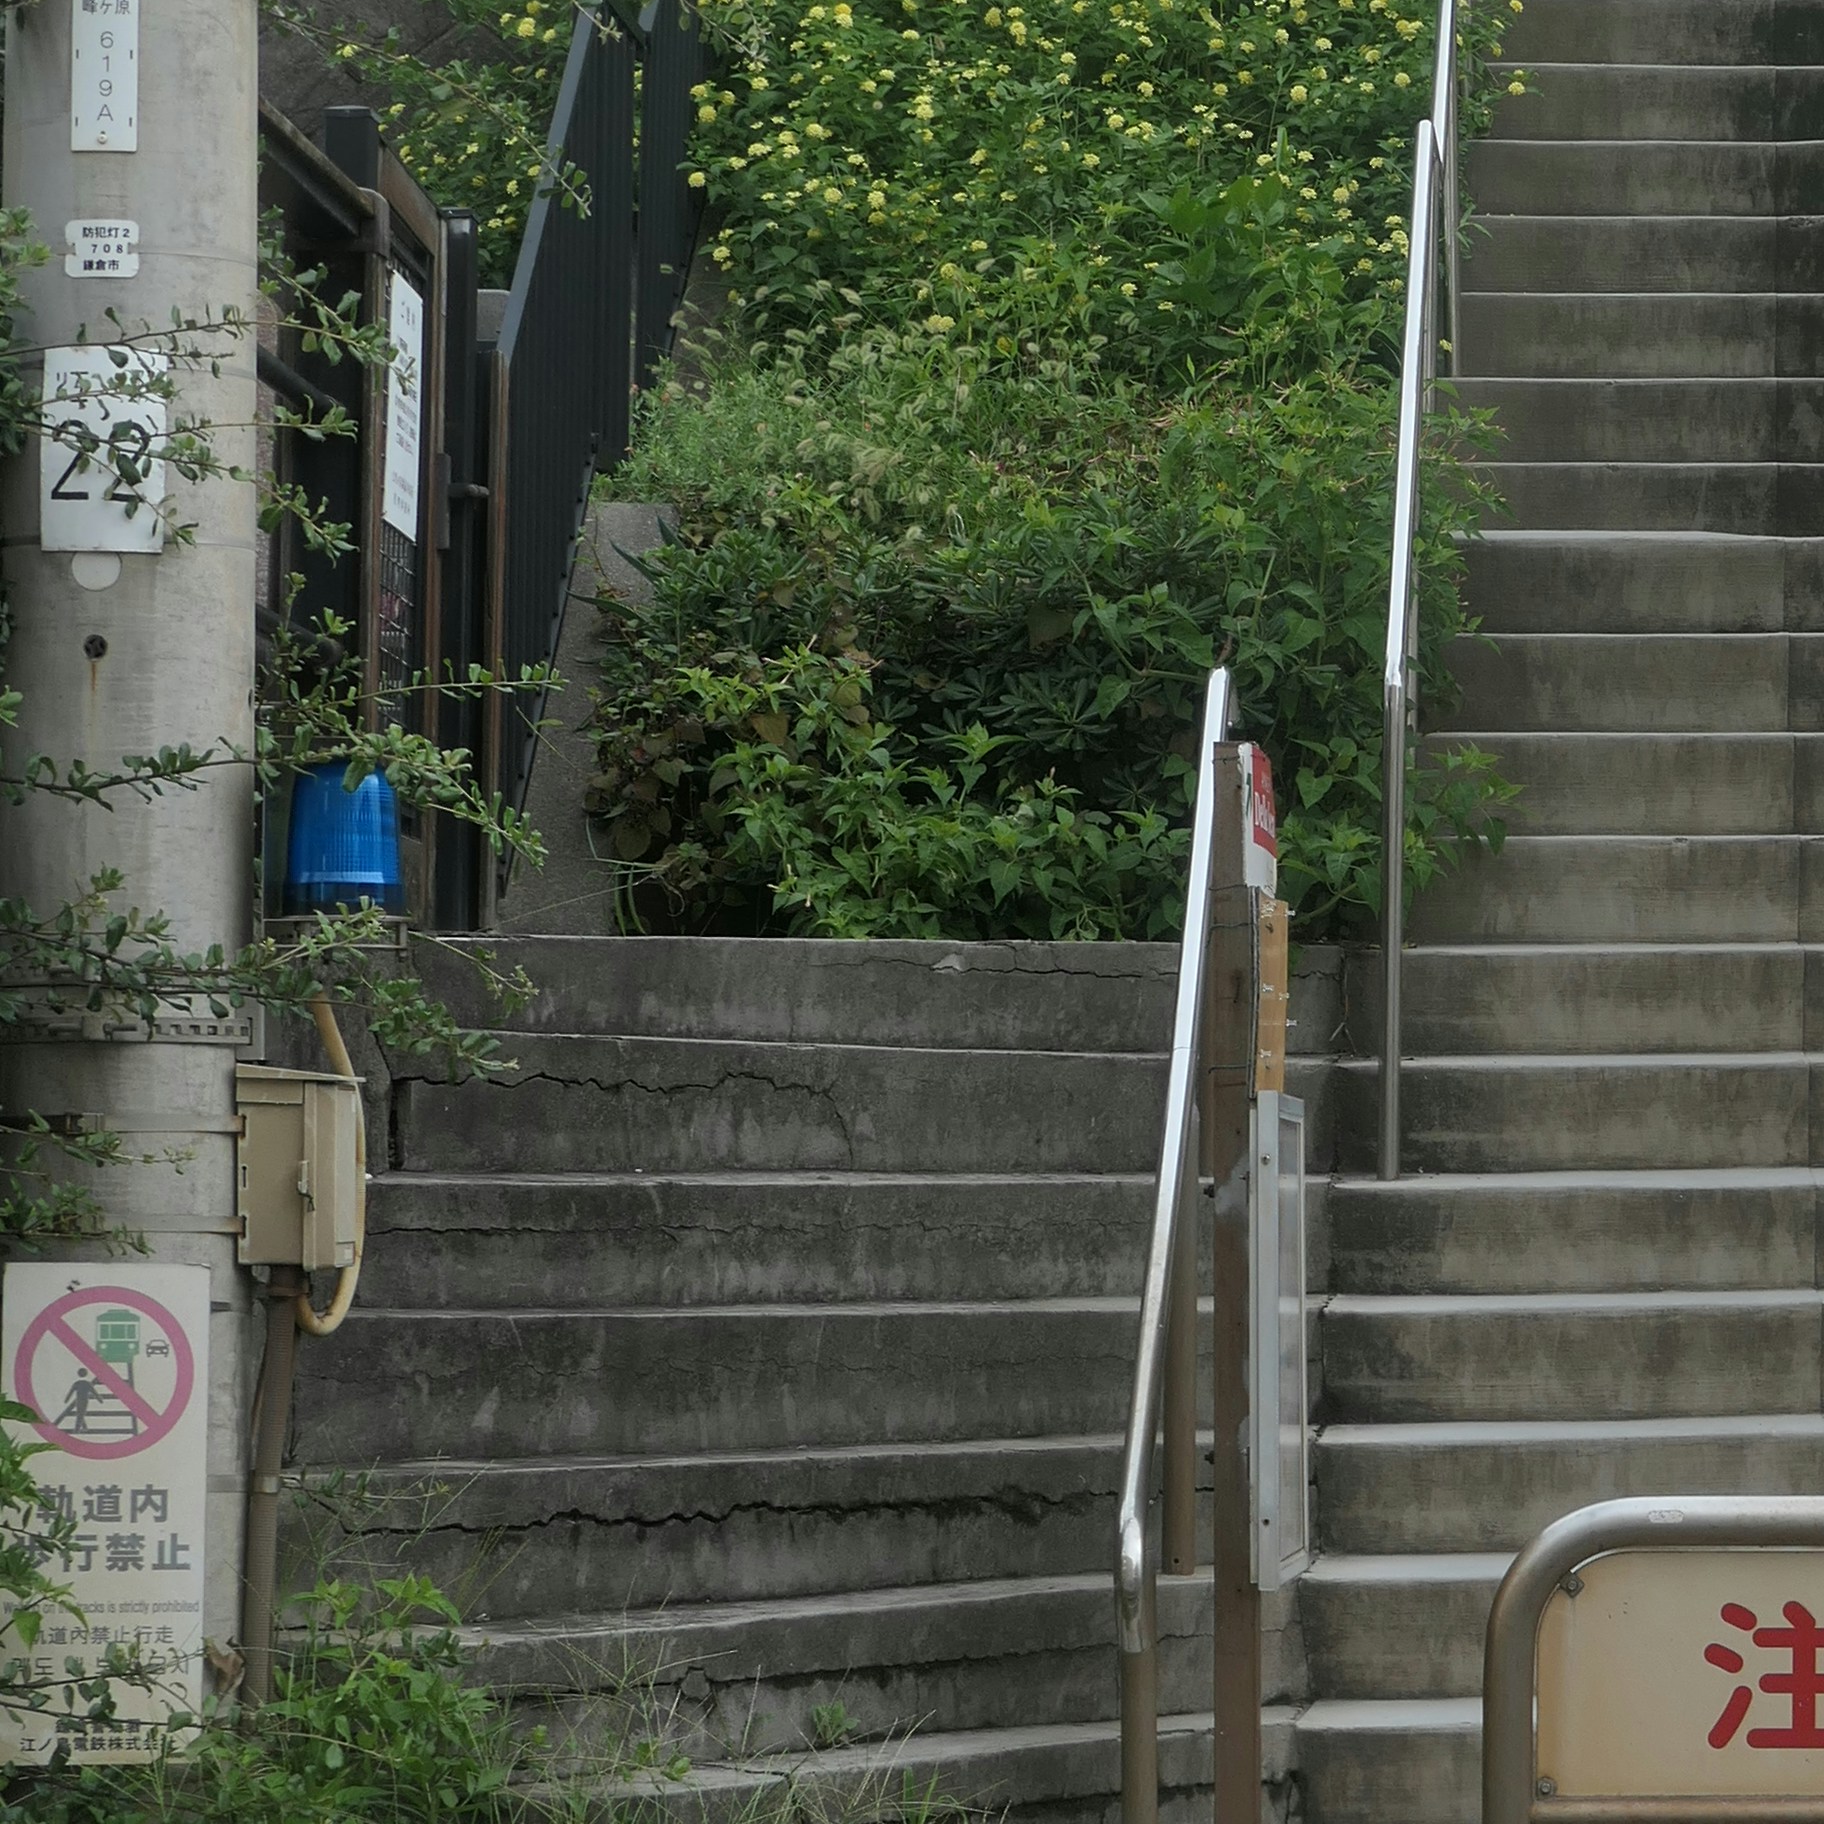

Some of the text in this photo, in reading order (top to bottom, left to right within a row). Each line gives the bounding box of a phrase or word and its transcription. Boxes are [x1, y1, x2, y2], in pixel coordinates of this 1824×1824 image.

[36, 1484, 168, 1523] 軌道内
[77, 1600, 105, 1614] racks
[152, 1600, 200, 1615] prohibited
[20, 1737, 176, 1753] 江ノ電鉄株式会社
